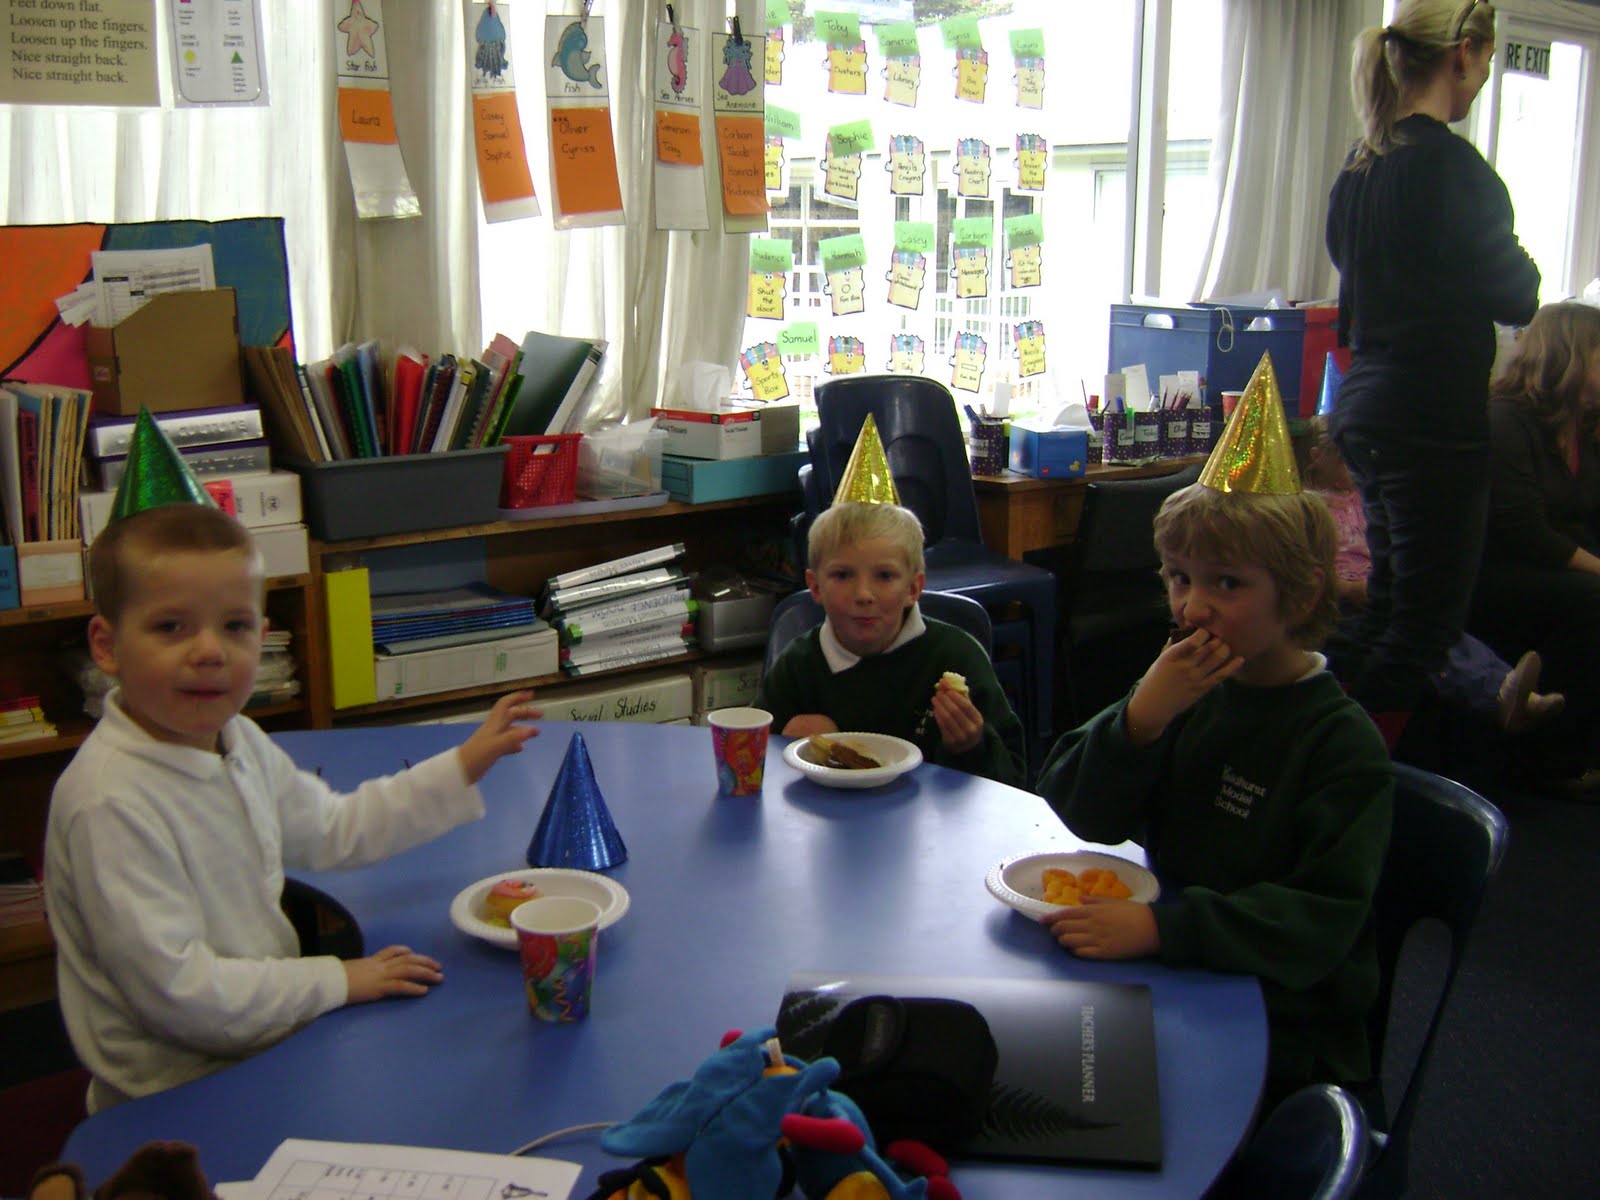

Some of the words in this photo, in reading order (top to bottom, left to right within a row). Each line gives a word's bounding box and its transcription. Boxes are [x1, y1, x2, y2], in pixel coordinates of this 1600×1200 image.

[40, 0, 74, 10] down
[10, 14, 56, 27] Loosen
[61, 20, 76, 31] up
[80, 18, 98, 30] the
[103, 19, 147, 34] fingers.
[823, 19, 849, 38] Toby
[11, 32, 57, 45] Loosen
[61, 37, 76, 48] up
[80, 35, 99, 48] the
[103, 37, 148, 51] fingers.
[880, 36, 916, 47] Cameron
[12, 50, 41, 62] Nice
[45, 53, 91, 66] straight
[95, 54, 128, 66] back.
[1504, 43, 1521, 70] RE
[1525, 46, 1550, 74] EXIT
[12, 68, 42, 80] Nice
[46, 70, 92, 84] straight
[96, 71, 128, 83] back.
[893, 73, 915, 90] Library
[564, 82, 580, 93] Fish
[717, 92, 728, 101] Sea
[352, 108, 381, 126] Laura
[560, 120, 588, 134] Oliver
[836, 131, 869, 149] Sophie
[900, 231, 928, 249] Casey
[831, 248, 862, 260] Hannah
[757, 287, 775, 296] Shut
[756, 304, 775, 313] door
[763, 297, 774, 305] the
[782, 329, 817, 344] Samuel
[756, 371, 780, 387] Sports
[764, 385, 780, 396] Box
[570, 705, 603, 721] Social
[614, 697, 657, 718] Studies
[1215, 795, 1250, 819] School
[1081, 1053, 1095, 1102] PLANNER
